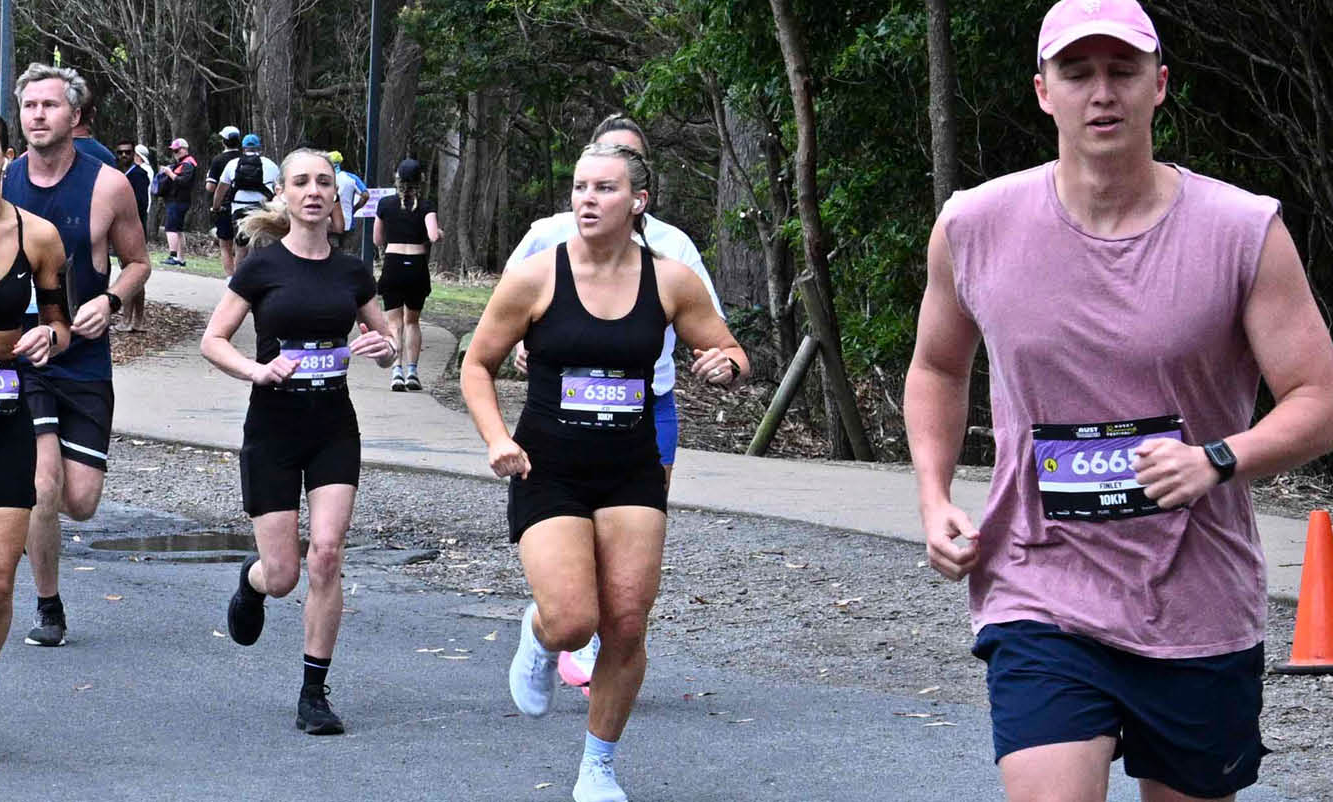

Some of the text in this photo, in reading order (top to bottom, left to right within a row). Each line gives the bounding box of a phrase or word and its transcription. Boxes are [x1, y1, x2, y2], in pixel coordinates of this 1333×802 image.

[300, 354, 335, 370] 6813
[583, 384, 627, 401] 6385
[1098, 481, 1123, 490] FINLEY
[1098, 493, 1128, 506] 10KM
